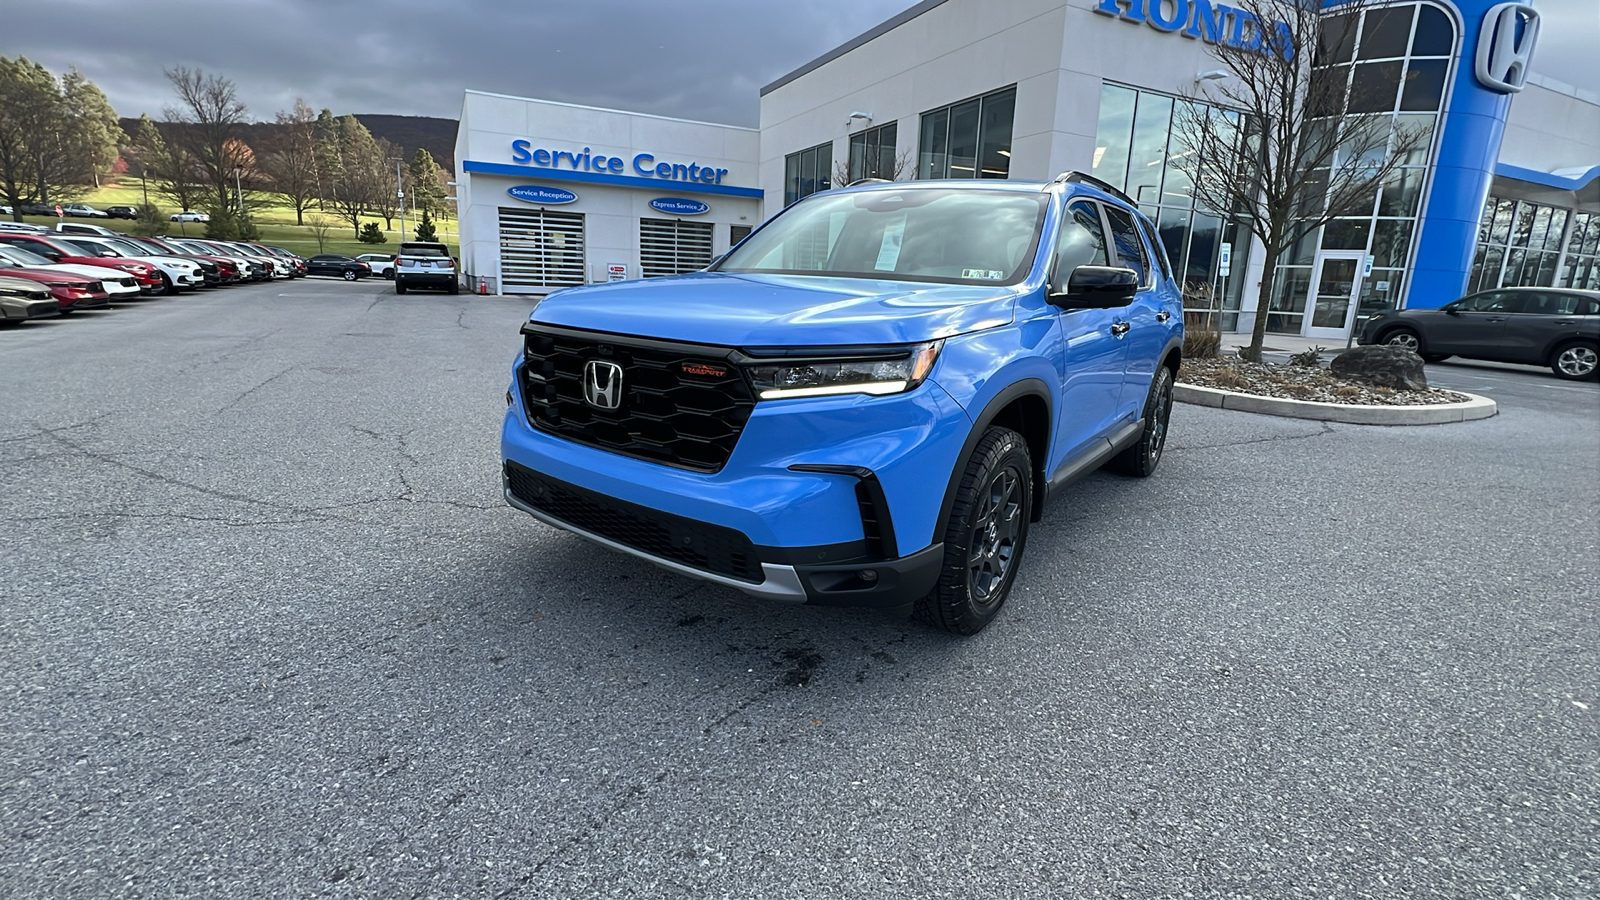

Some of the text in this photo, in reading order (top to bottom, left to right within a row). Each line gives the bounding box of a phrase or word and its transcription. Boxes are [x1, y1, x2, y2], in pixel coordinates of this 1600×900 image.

[512, 139, 728, 184] Service Center
[511, 189, 573, 200] Service Reception
[653, 201, 697, 211] Express Service
